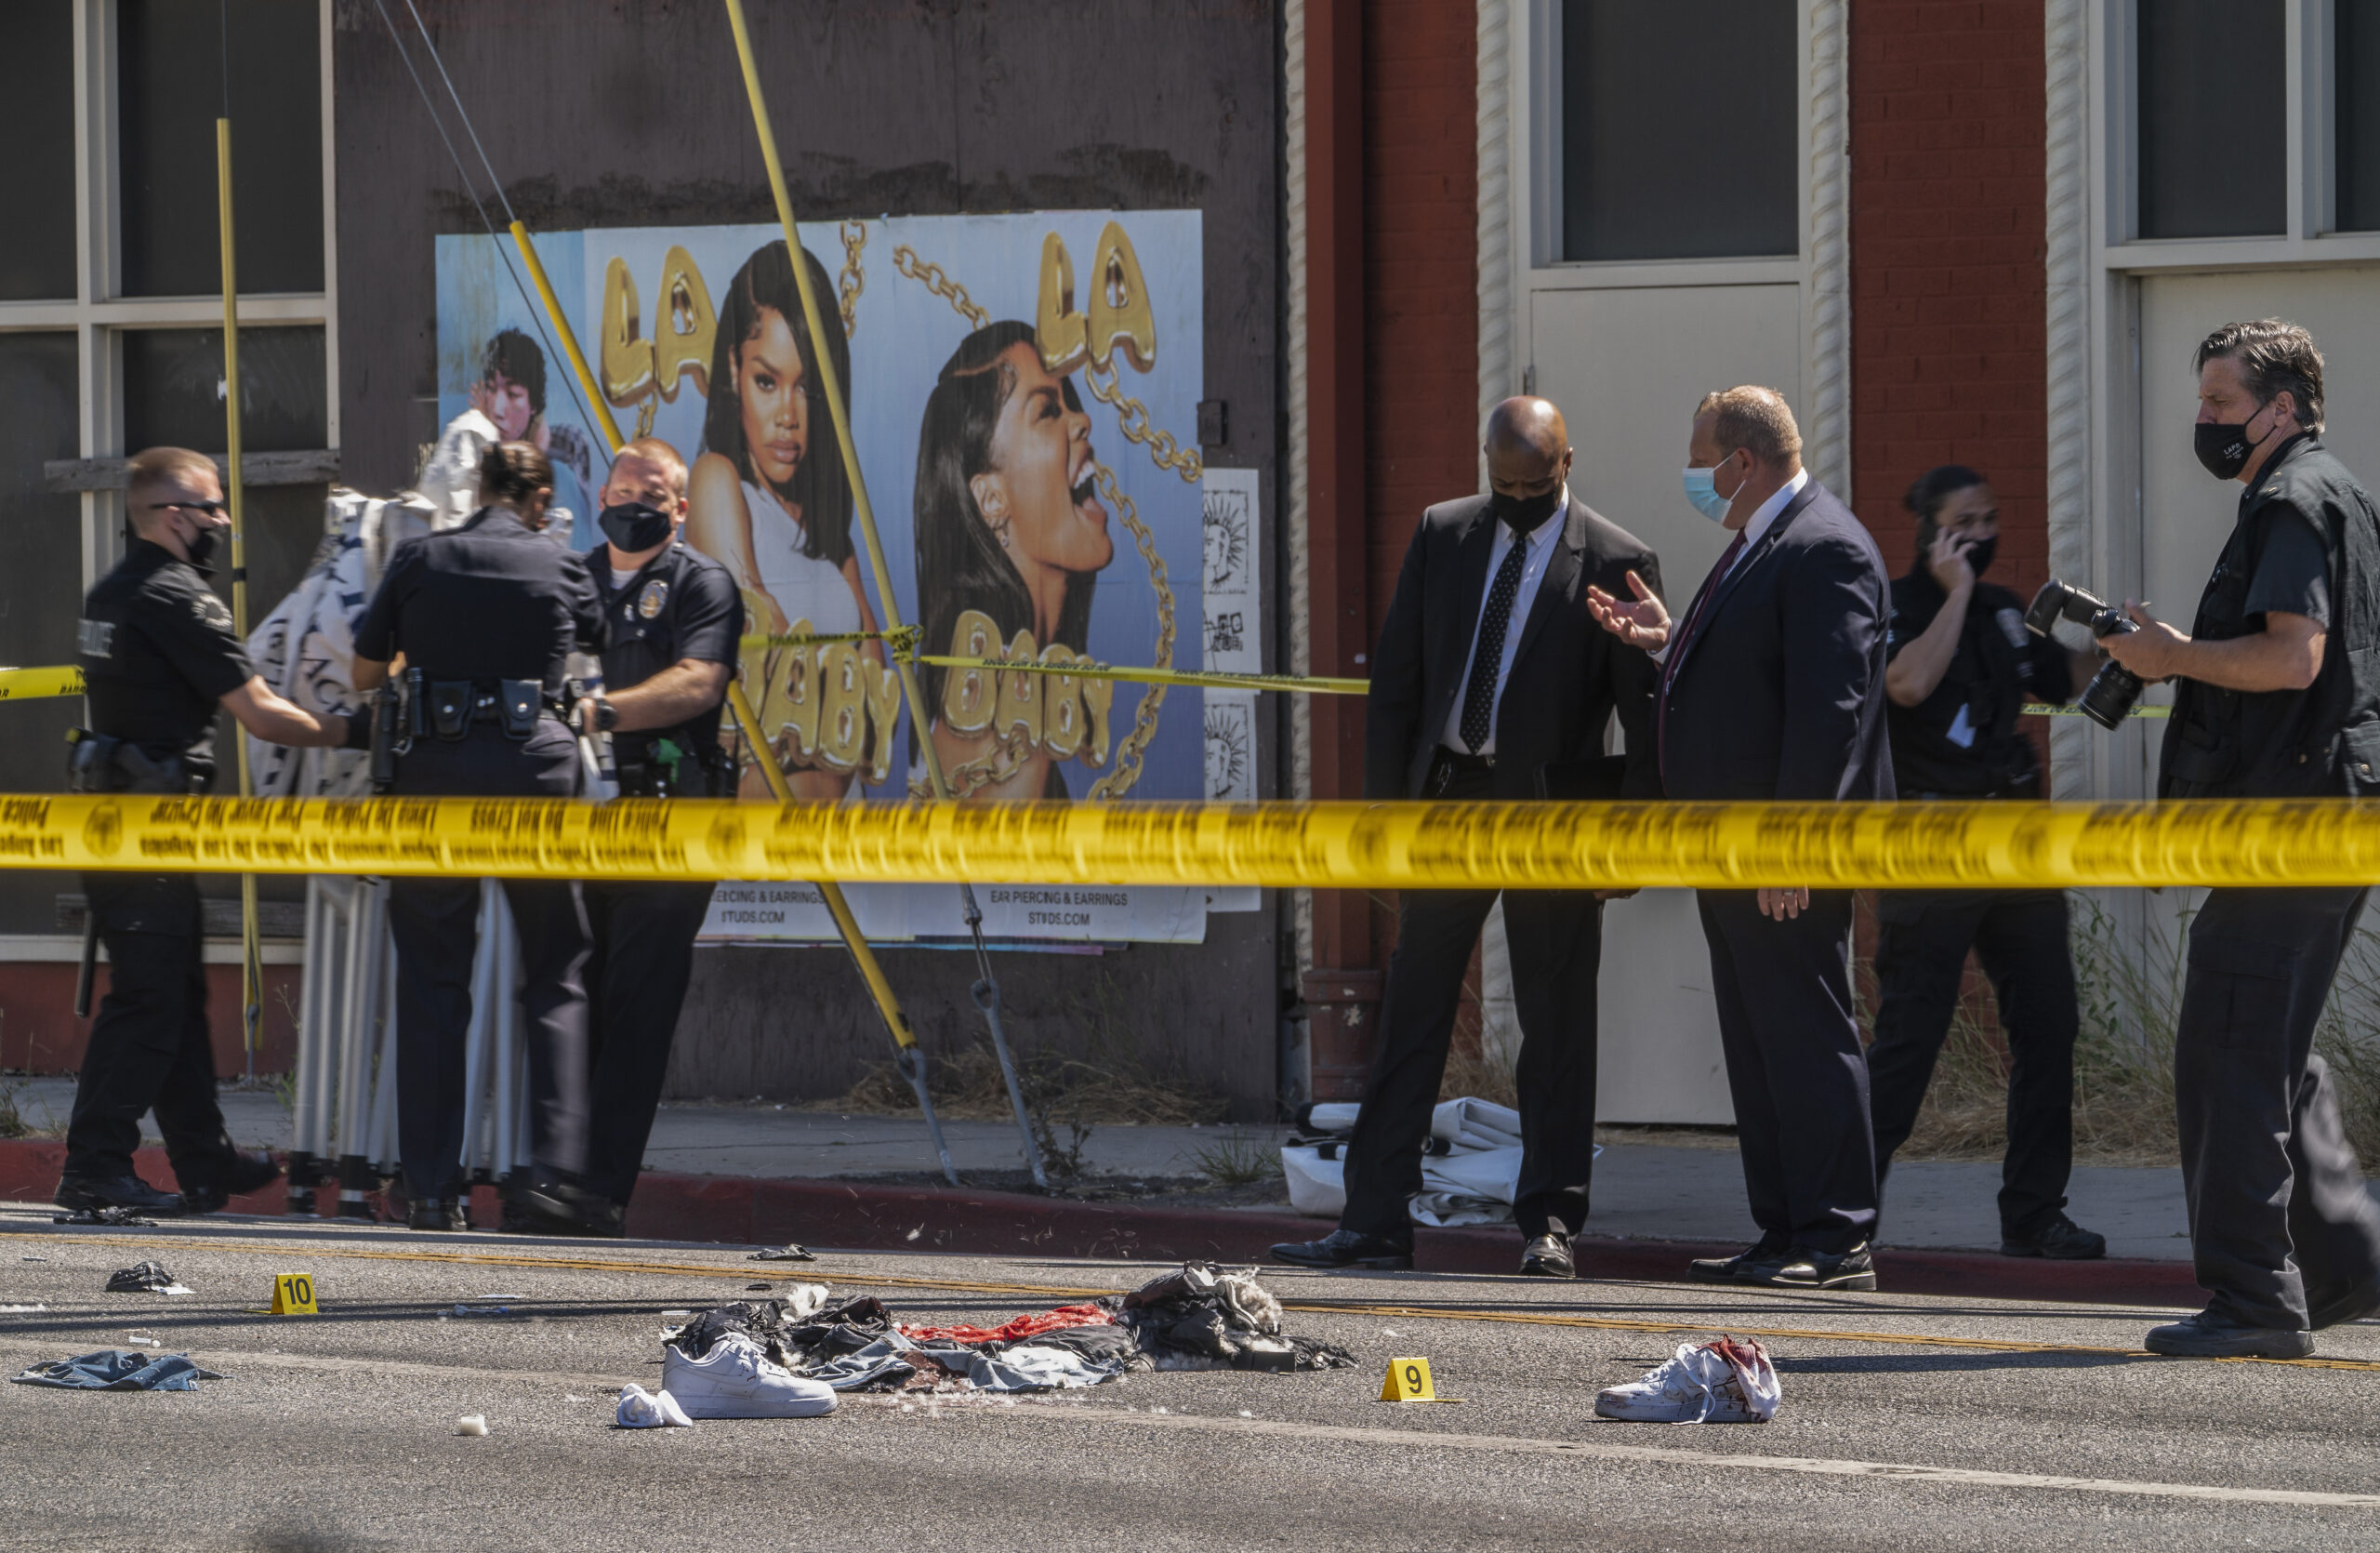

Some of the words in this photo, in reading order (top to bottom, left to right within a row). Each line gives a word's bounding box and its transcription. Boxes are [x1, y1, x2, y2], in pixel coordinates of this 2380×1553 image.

[1035, 219, 1157, 377] LA
[600, 245, 718, 408] LA
[941, 610, 1114, 769] BABY
[758, 890, 767, 903] &
[990, 890, 1011, 903] EAR
[1012, 891, 1062, 904] PIERCING
[1063, 893, 1072, 905] &
[1074, 893, 1128, 906] EARRINGS
[721, 910, 786, 923] STUDS.COM
[1028, 911, 1091, 925] STUDS.COM
[283, 1278, 311, 1306] 10
[1405, 1365, 1422, 1394] 9
